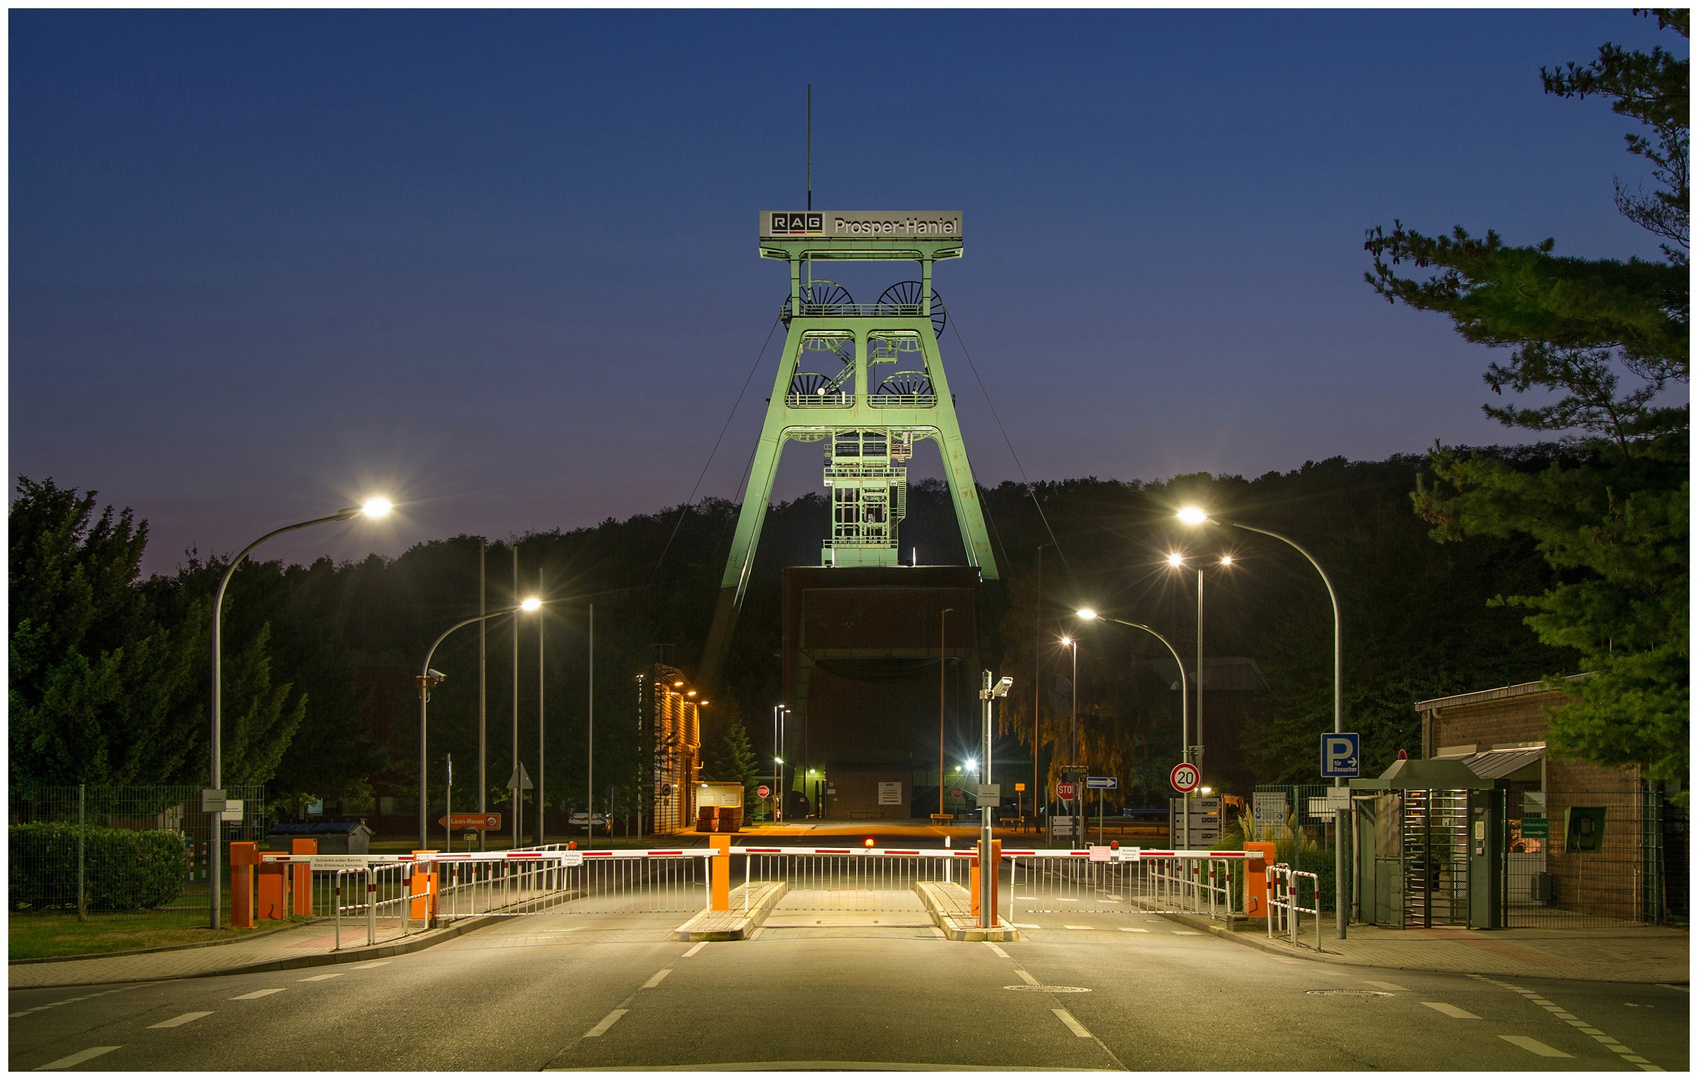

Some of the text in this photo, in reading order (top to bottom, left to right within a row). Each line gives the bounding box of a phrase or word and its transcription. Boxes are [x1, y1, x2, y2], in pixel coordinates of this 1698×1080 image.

[775, 217, 820, 228] RAG
[835, 217, 957, 236] Prosper-Haniel
[1327, 737, 1353, 772] P
[1177, 771, 1194, 784] 20
[1058, 785, 1074, 794] STO
